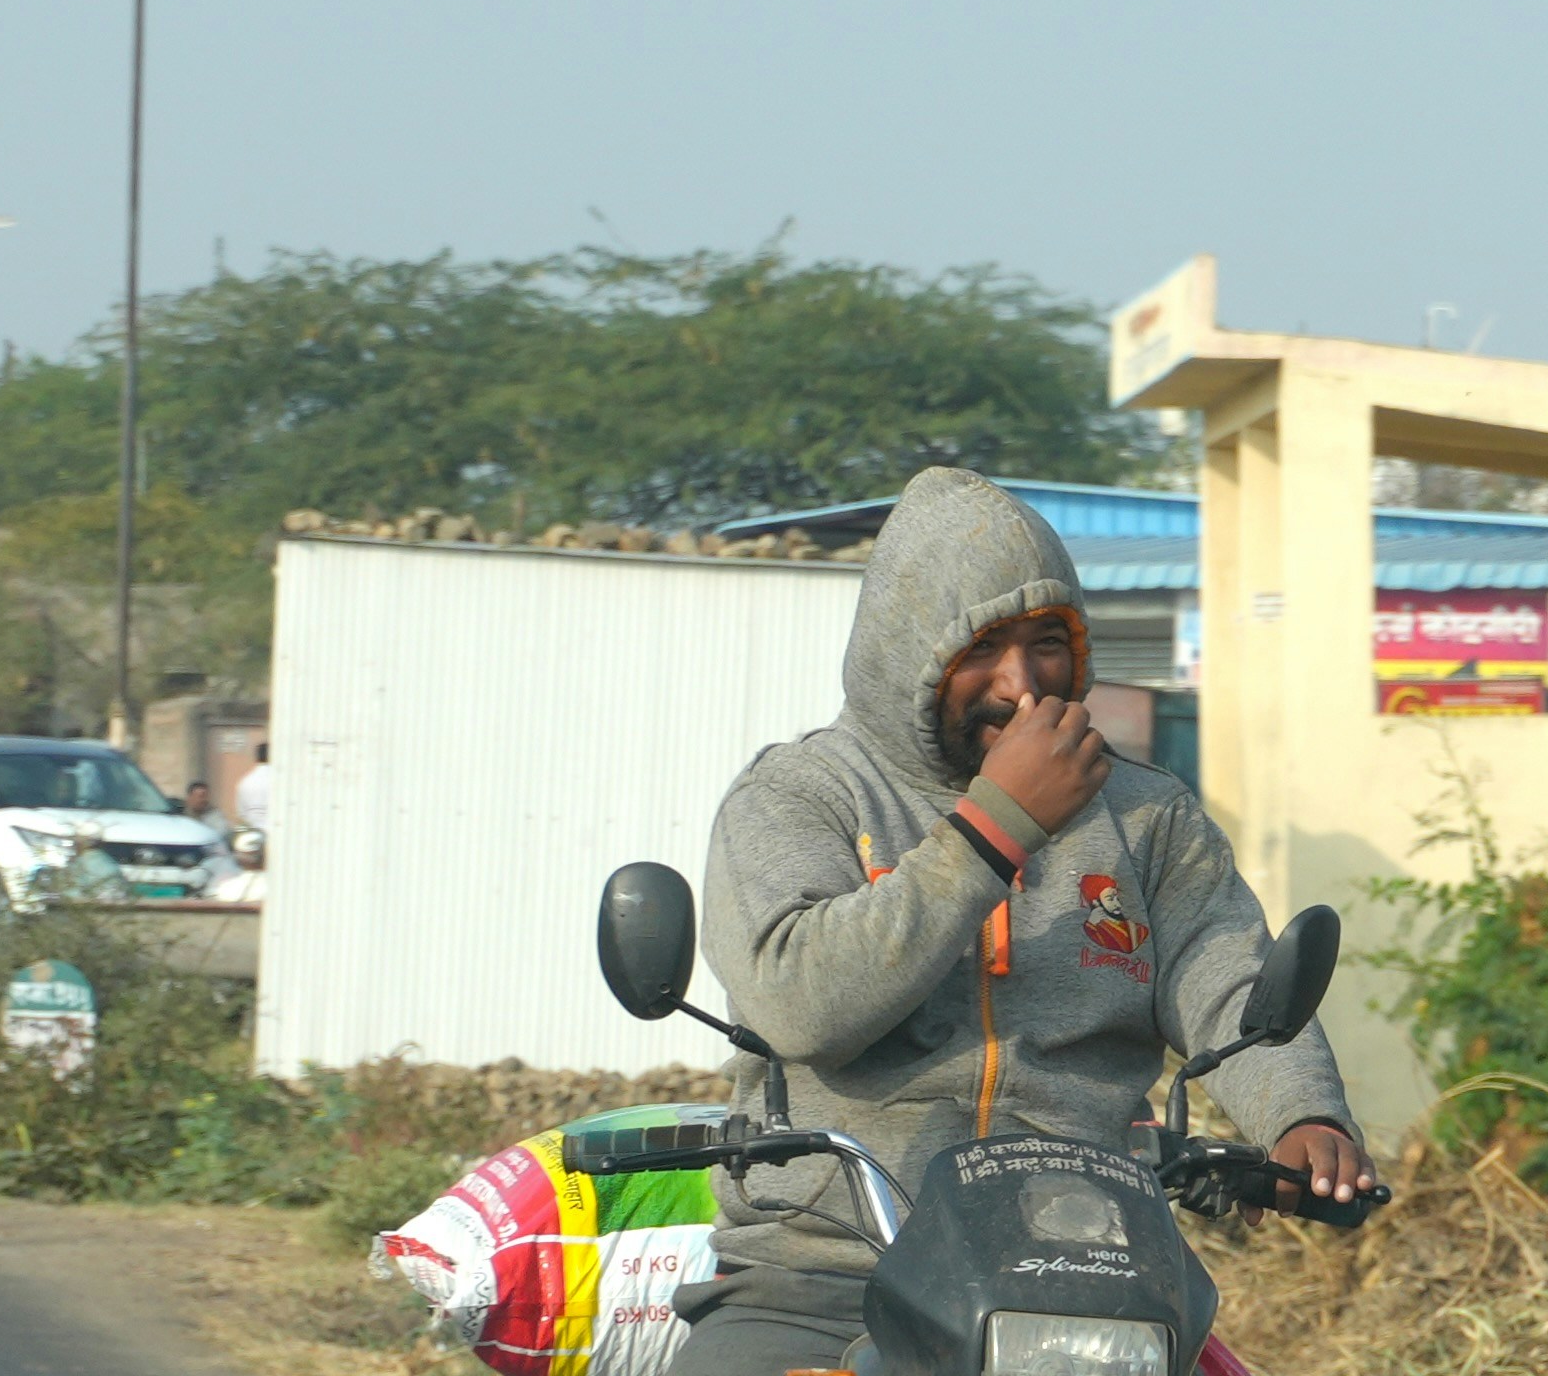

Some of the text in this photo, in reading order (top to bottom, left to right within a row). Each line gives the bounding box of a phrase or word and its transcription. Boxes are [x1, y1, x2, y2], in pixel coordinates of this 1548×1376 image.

[621, 1255, 678, 1276] 50 KG
[1087, 1248, 1130, 1264] Hero
[613, 1304, 670, 1324] 50 KG
